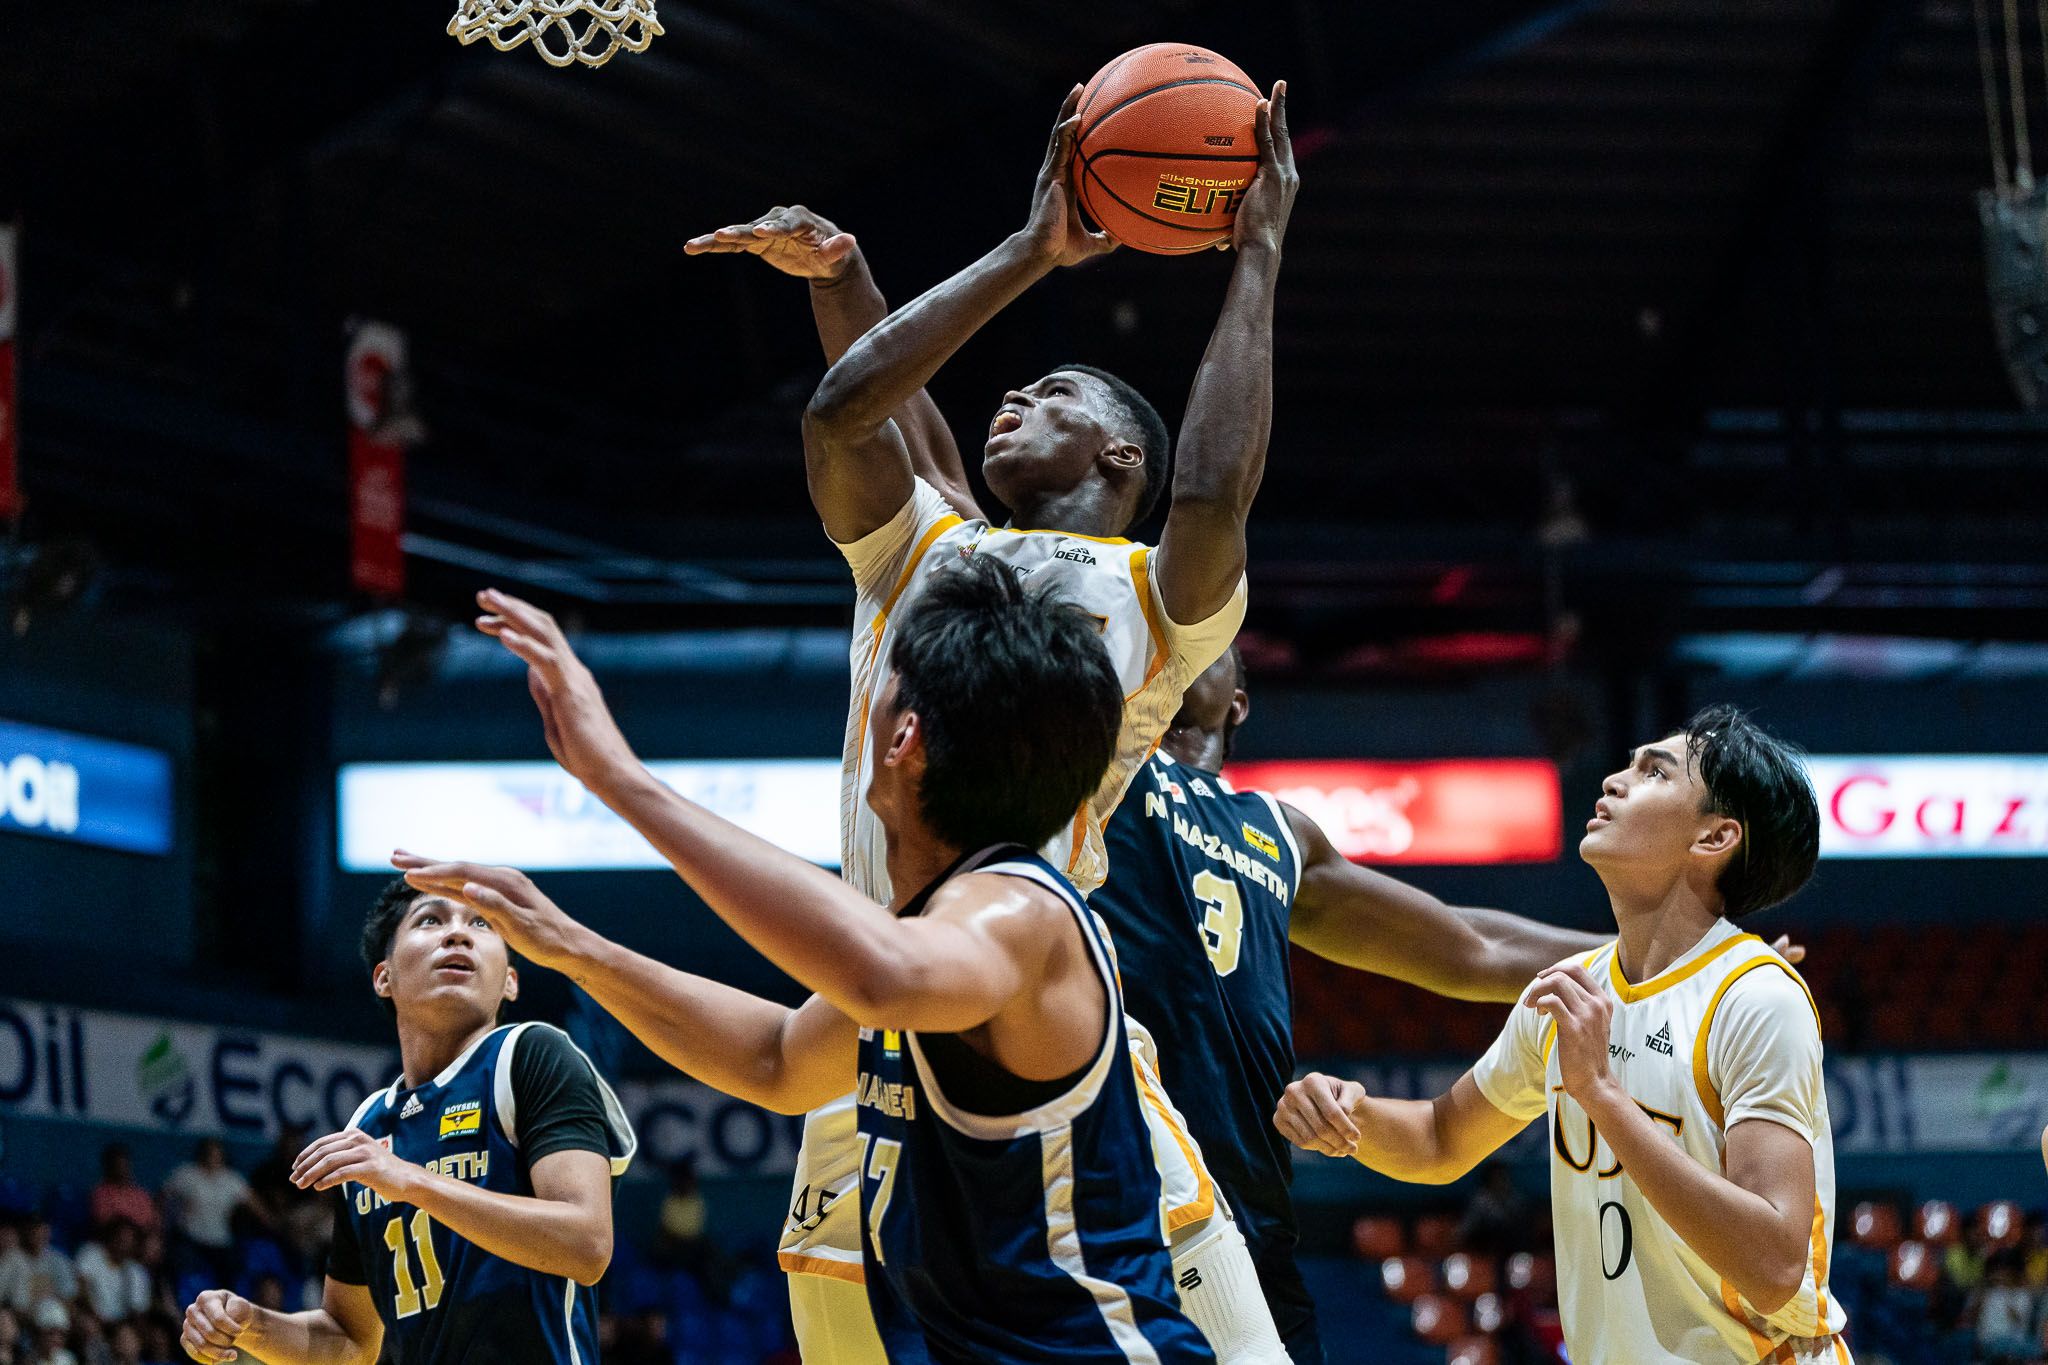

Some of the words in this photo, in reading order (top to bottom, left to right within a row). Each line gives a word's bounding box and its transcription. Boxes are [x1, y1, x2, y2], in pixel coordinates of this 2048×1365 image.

[1160, 173, 1245, 187] AMPIONSHIP
[1054, 550, 1097, 566] DELTA
[1173, 811, 1289, 908] NAZARETH
[1192, 868, 1243, 977] 3
[212, 1036, 406, 1132] Eco
[444, 1100, 480, 1116] BOYSEN
[383, 1208, 446, 1320] 11
